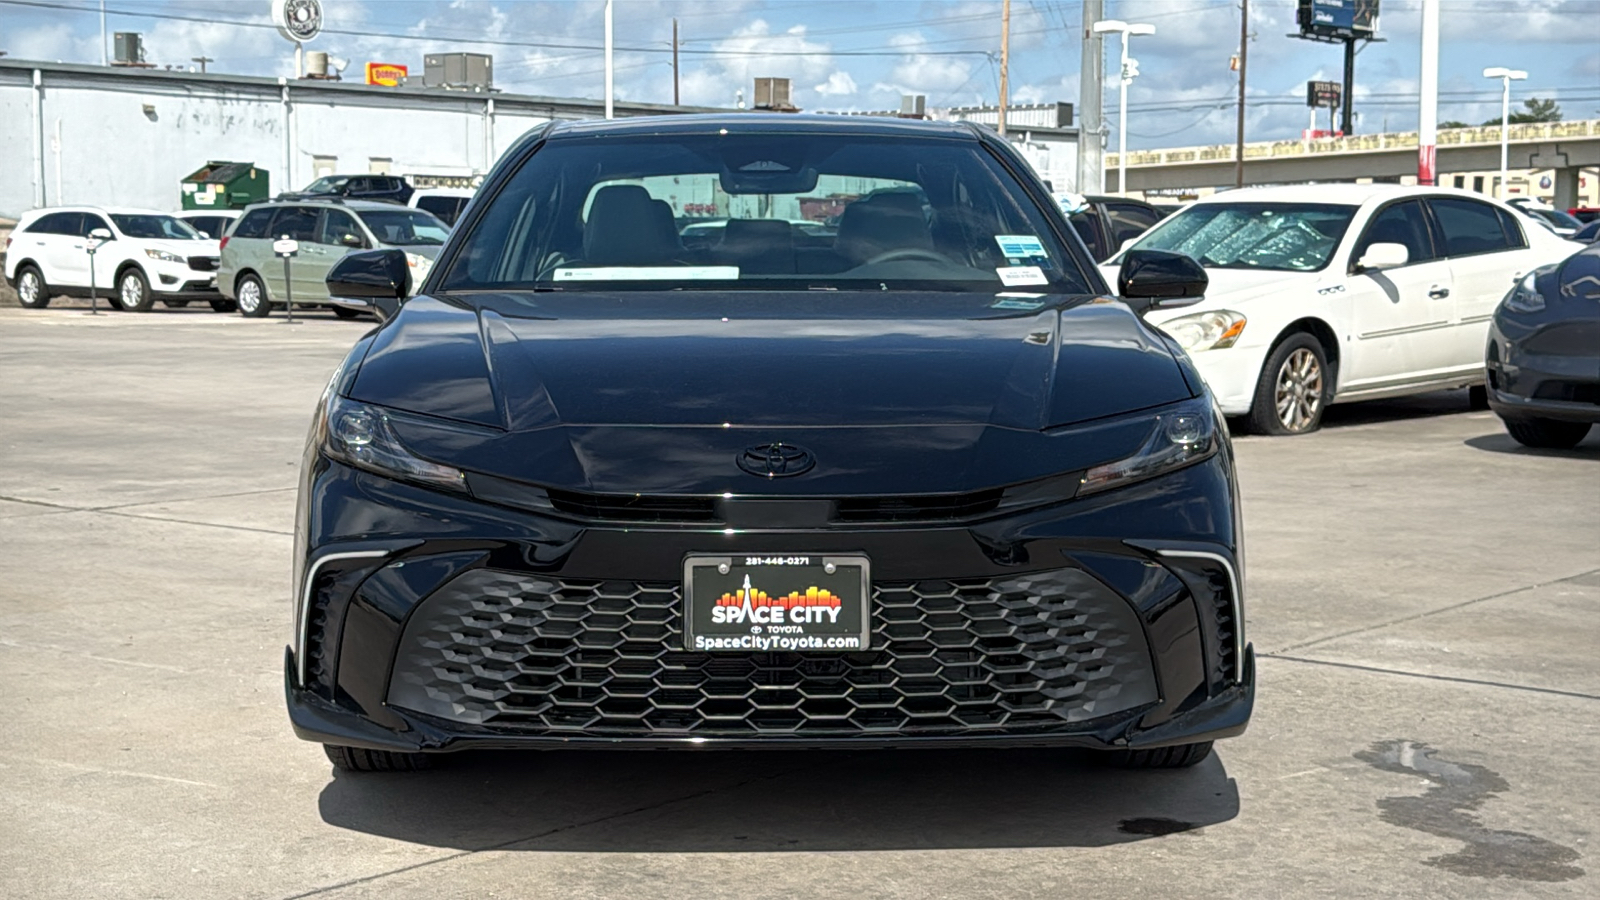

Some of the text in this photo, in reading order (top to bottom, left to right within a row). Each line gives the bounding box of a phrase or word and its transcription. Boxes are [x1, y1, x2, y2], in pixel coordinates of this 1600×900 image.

[745, 556, 810, 566] 281-446-0271
[711, 605, 842, 623] SPACE CITY
[767, 625, 804, 635] TOYOTA
[695, 635, 860, 651] SpaceCityToyota.com
